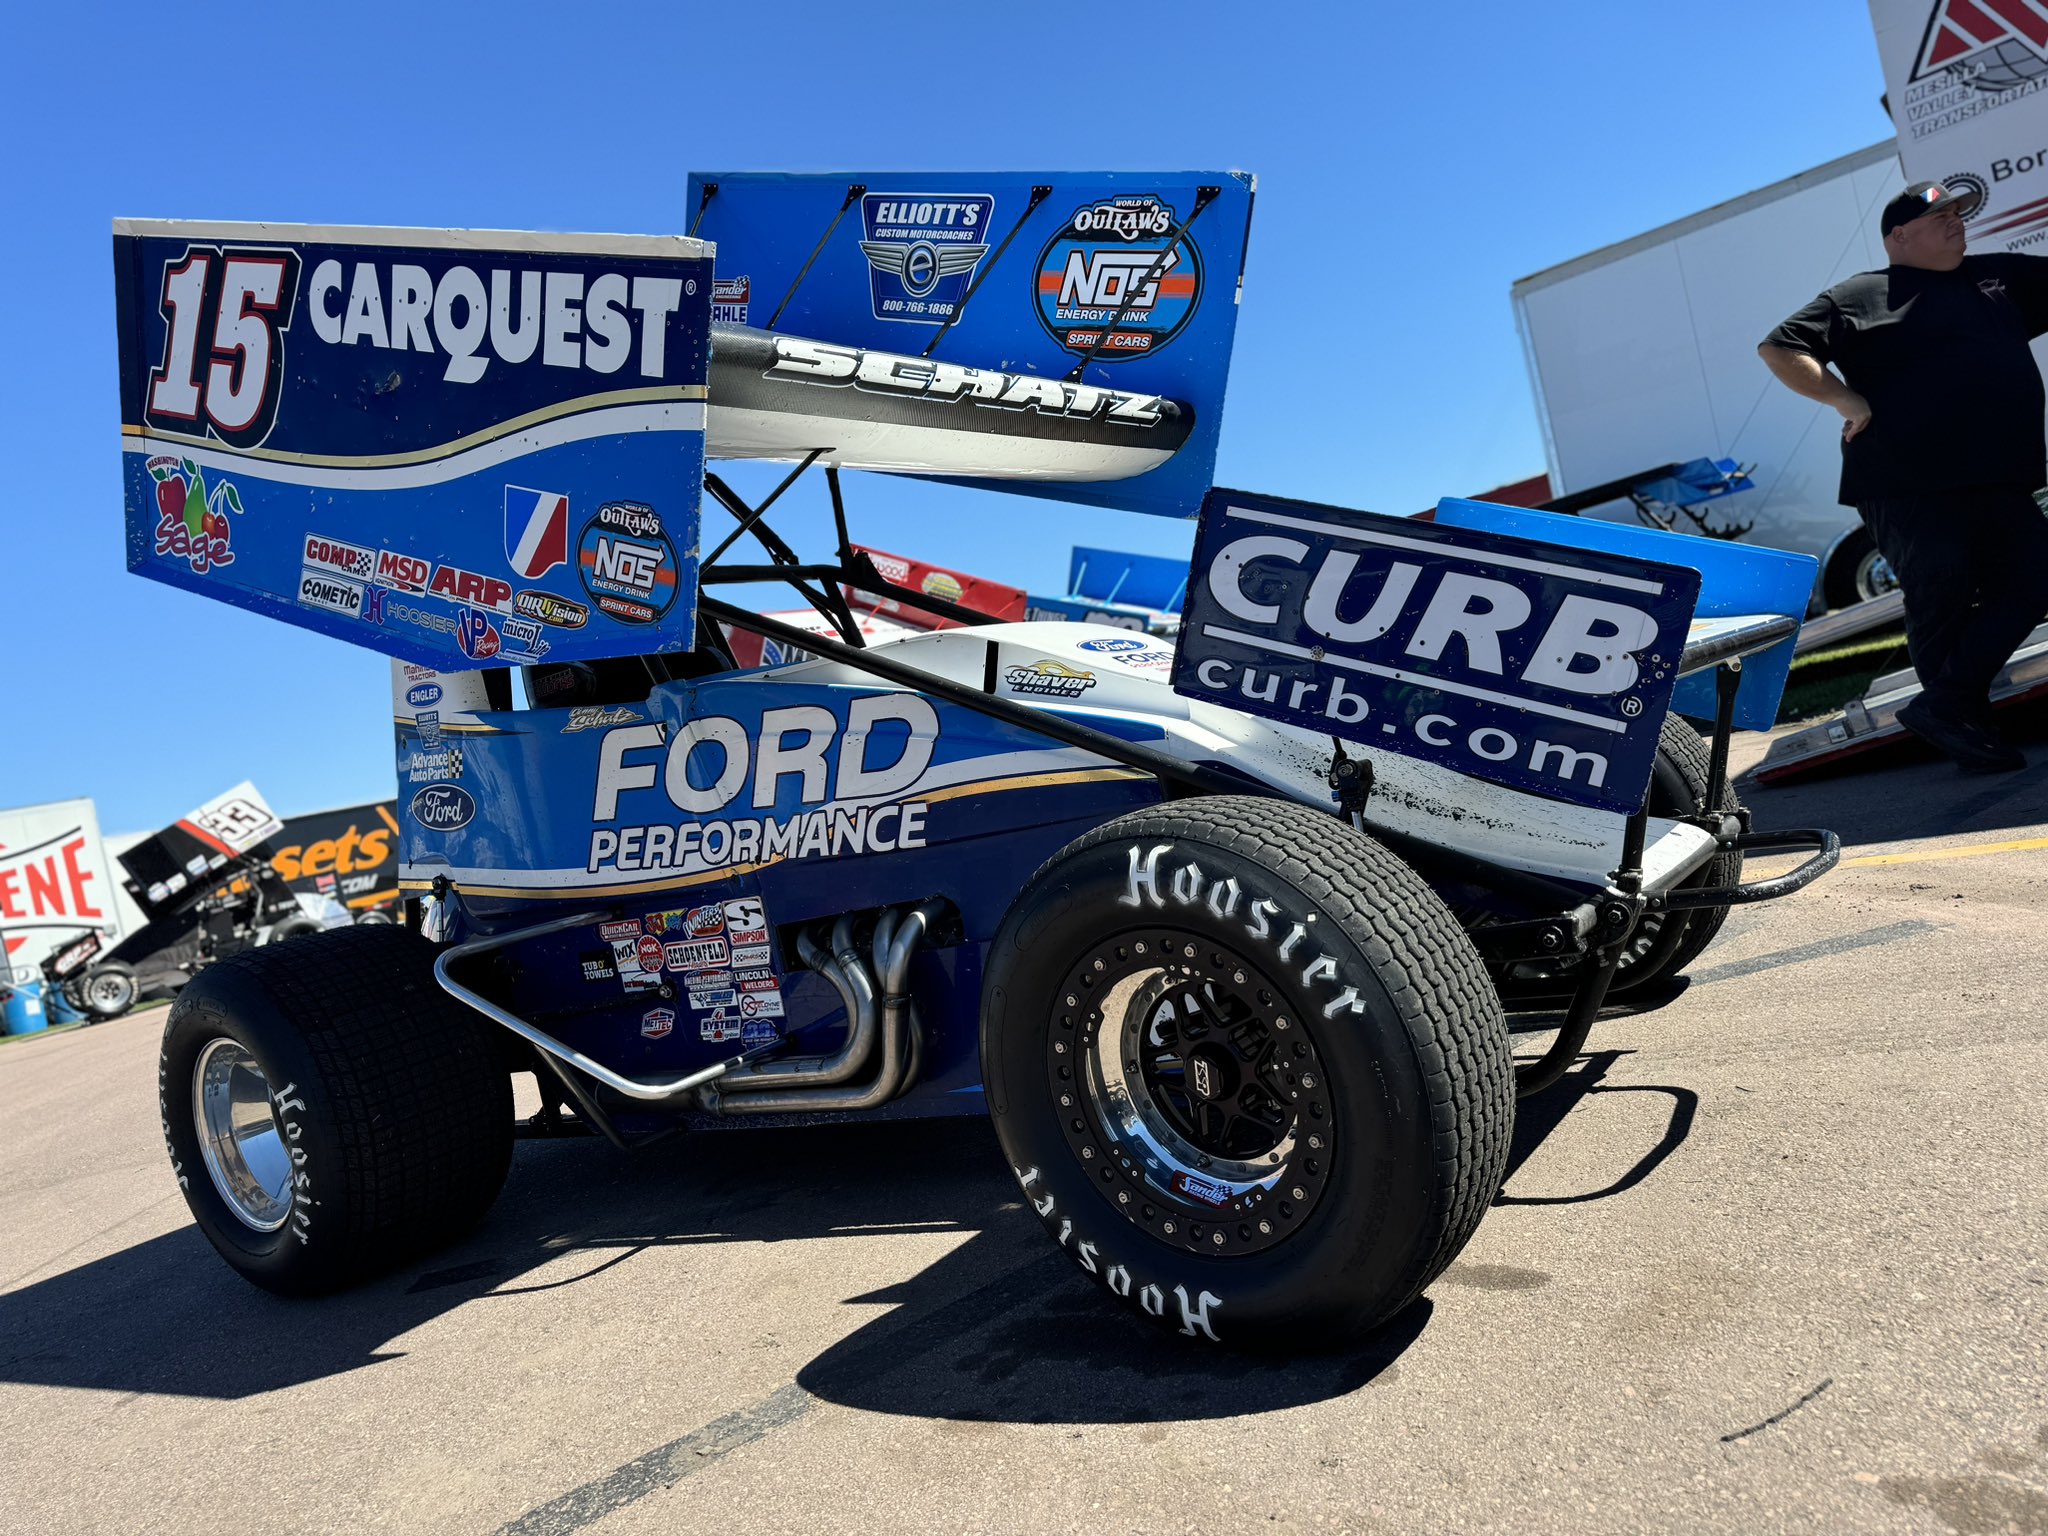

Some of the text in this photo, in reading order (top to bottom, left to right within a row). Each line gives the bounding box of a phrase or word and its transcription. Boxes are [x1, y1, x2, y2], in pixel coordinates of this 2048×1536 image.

[1905, 61, 1987, 104] MESILLA
[1906, 84, 1977, 122] VALLEY
[1912, 75, 2048, 139] TRANSPORTAT
[876, 202, 980, 226] ELLIOTT'S
[1115, 199, 1142, 207] WORLD
[875, 228, 974, 240] CUSTOM MOTORCOACHES
[714, 283, 747, 295] ander
[1057, 250, 1180, 308] NOS
[713, 305, 747, 323] AHLE
[883, 300, 954, 315] 800-766-1886
[1055, 309, 1106, 320] ENERGY
[310, 259, 683, 383] CARQUEST
[148, 252, 290, 432] 15
[1068, 333, 1150, 347] SPRIT CARS
[763, 337, 1167, 428] SCHATZ
[147, 456, 179, 470] WASHINGTON
[625, 504, 641, 512] WORLD
[306, 539, 357, 568] COMP
[593, 537, 665, 589] NOS
[341, 564, 367, 577] CAMS
[379, 552, 428, 584] MSD
[302, 579, 360, 609] COMETIC
[430, 565, 512, 608] ARP
[592, 578, 651, 600] ENERGY DRINK
[386, 601, 458, 636] HOOSIER
[600, 600, 652, 619] SPRINT CARS
[1208, 535, 1659, 697] CURB
[458, 607, 488, 658] VP
[503, 621, 534, 641] micro
[1089, 639, 1138, 651] Ford
[408, 671, 437, 682] TRACTORS
[1004, 668, 1098, 691] Shaver
[410, 687, 439, 703] ENGLER
[1012, 685, 1081, 698] ENGINES
[1197, 658, 1610, 788] curb.com
[411, 752, 449, 769] Advance
[592, 693, 941, 823] FORD
[424, 791, 464, 823] Ford
[587, 802, 929, 874] PERFORMANCE
[683, 907, 721, 938] WINTERS
[1119, 843, 1366, 1018] Hoosier
[641, 943, 658, 954] NGK
[732, 930, 766, 944] SIMPSON
[614, 942, 636, 960] WIX
[667, 942, 726, 965] SCHOENFELD
[582, 961, 598, 972] TUB
[584, 968, 614, 980] TOWELS
[734, 970, 770, 981] LINCOLN
[743, 980, 775, 989] WELDERS
[702, 1020, 739, 1031] SYSTEM
[272, 1081, 322, 1246] Hoosier
[1179, 1176, 1229, 1202] Sander
[1014, 1162, 1223, 1342] Hoosier
